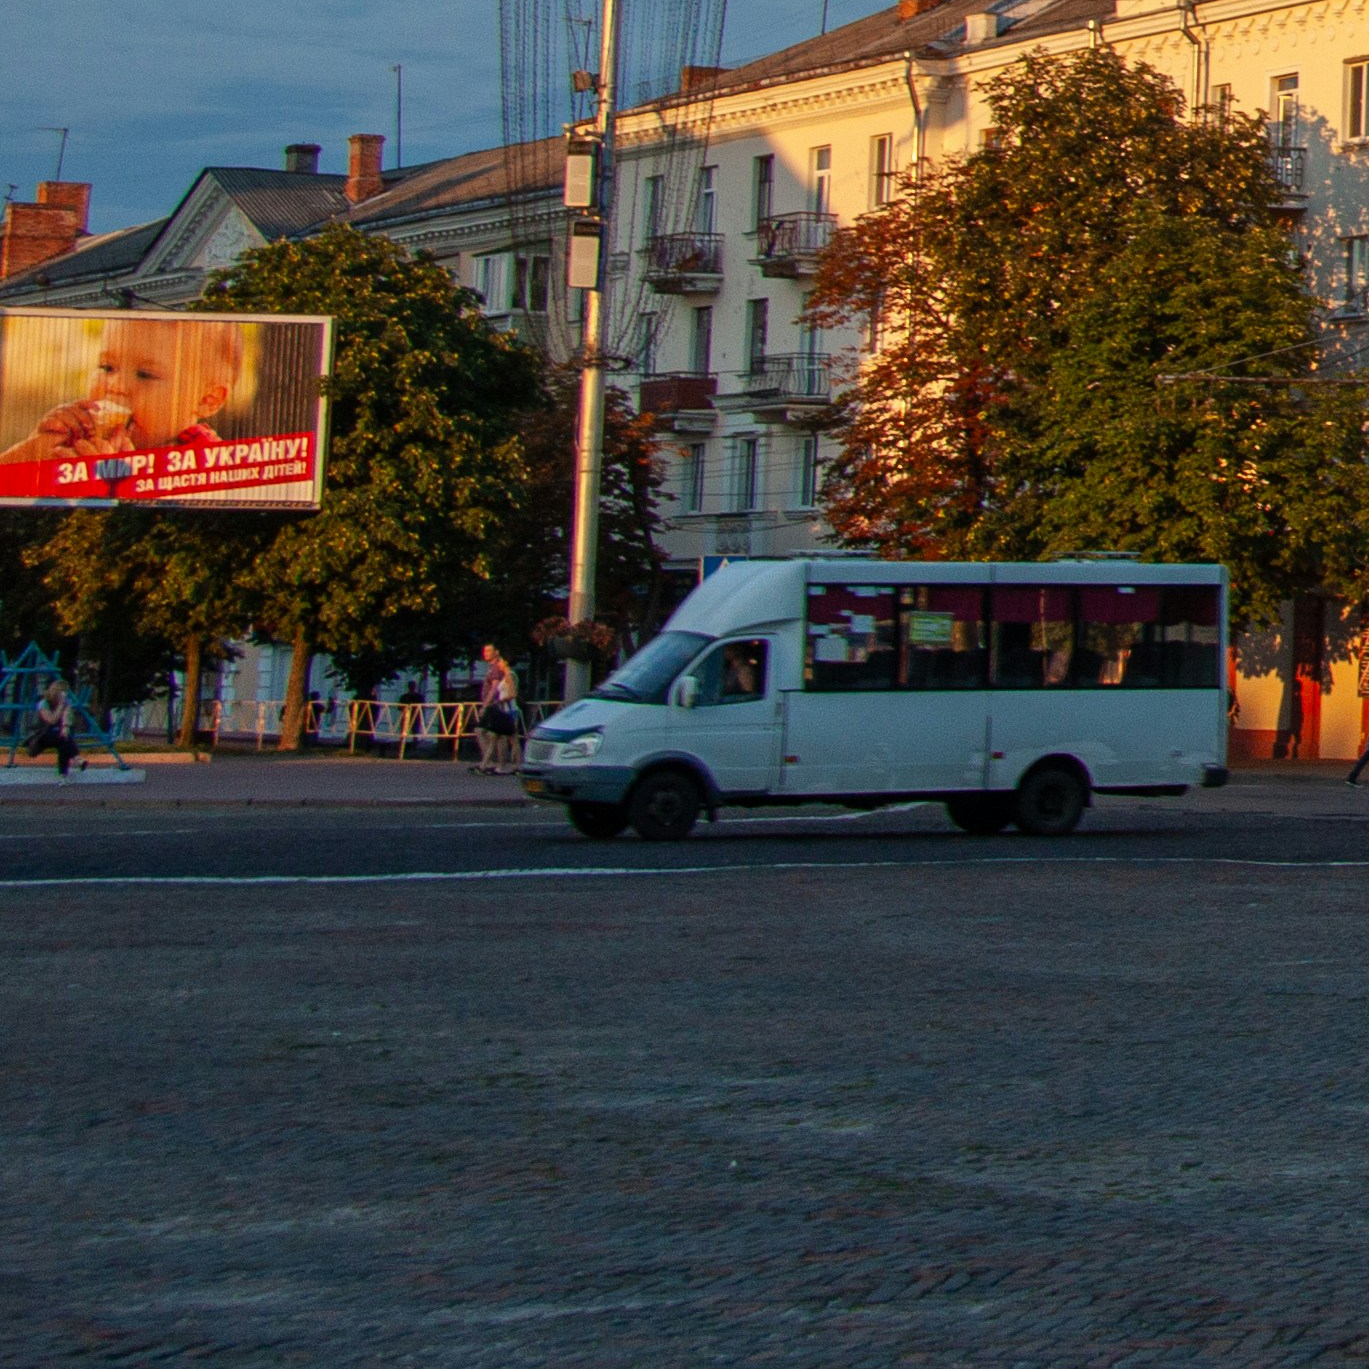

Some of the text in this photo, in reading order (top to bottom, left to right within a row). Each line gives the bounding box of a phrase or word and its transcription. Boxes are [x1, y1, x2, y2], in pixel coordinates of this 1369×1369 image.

[58, 437, 309, 484] ЗА МИР! ЗА УКРАЇНУ!
[135, 479, 154, 493] ЗА
[158, 472, 207, 491] ЩАСТЯ
[210, 466, 260, 485] НАШИХ
